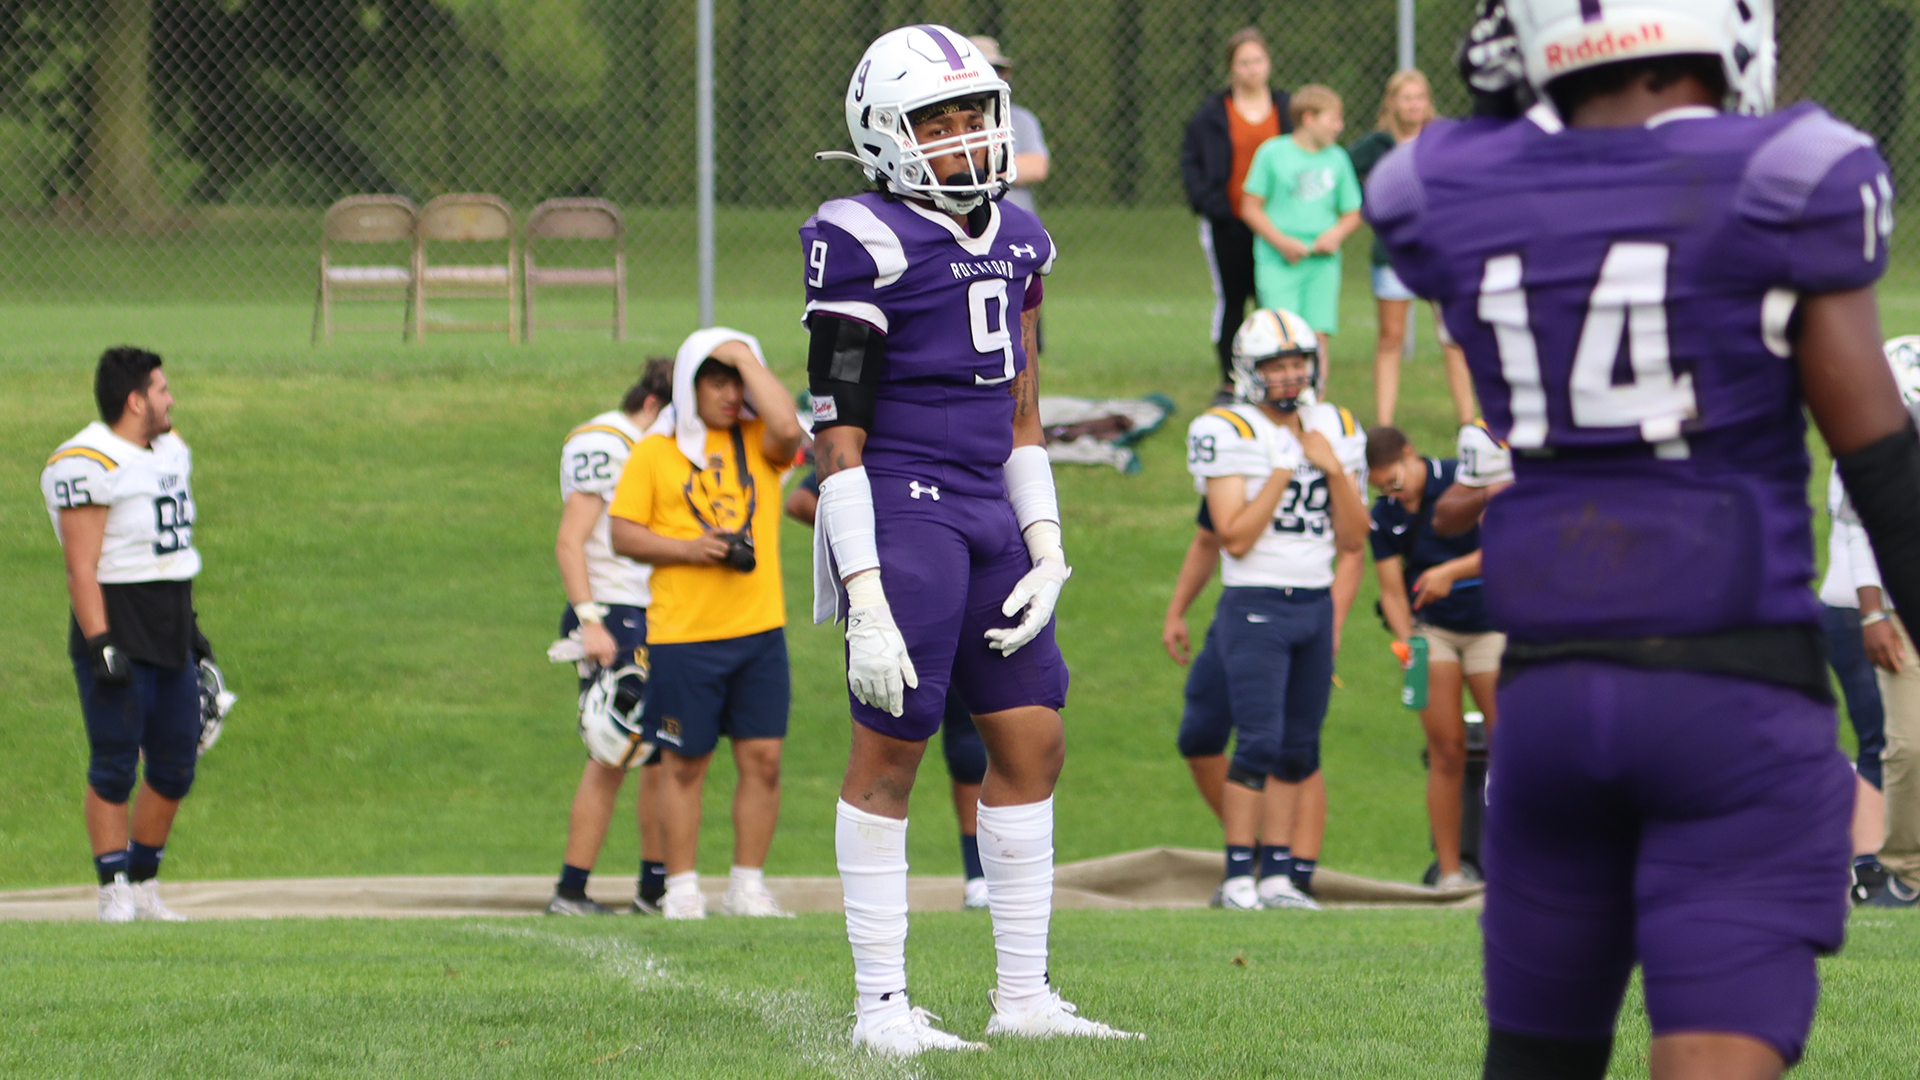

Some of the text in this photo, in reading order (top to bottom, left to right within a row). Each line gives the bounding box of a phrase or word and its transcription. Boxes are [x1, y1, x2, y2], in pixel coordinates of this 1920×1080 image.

[1545, 23, 1662, 69] Riddell
[855, 59, 871, 102] 9
[943, 70, 980, 83] Riddell
[808, 239, 828, 289] 9
[950, 260, 1014, 279] ROCKFORD
[968, 278, 1016, 385] 9
[1477, 242, 1697, 460] 14
[573, 451, 611, 482] 22
[55, 476, 92, 508] 95
